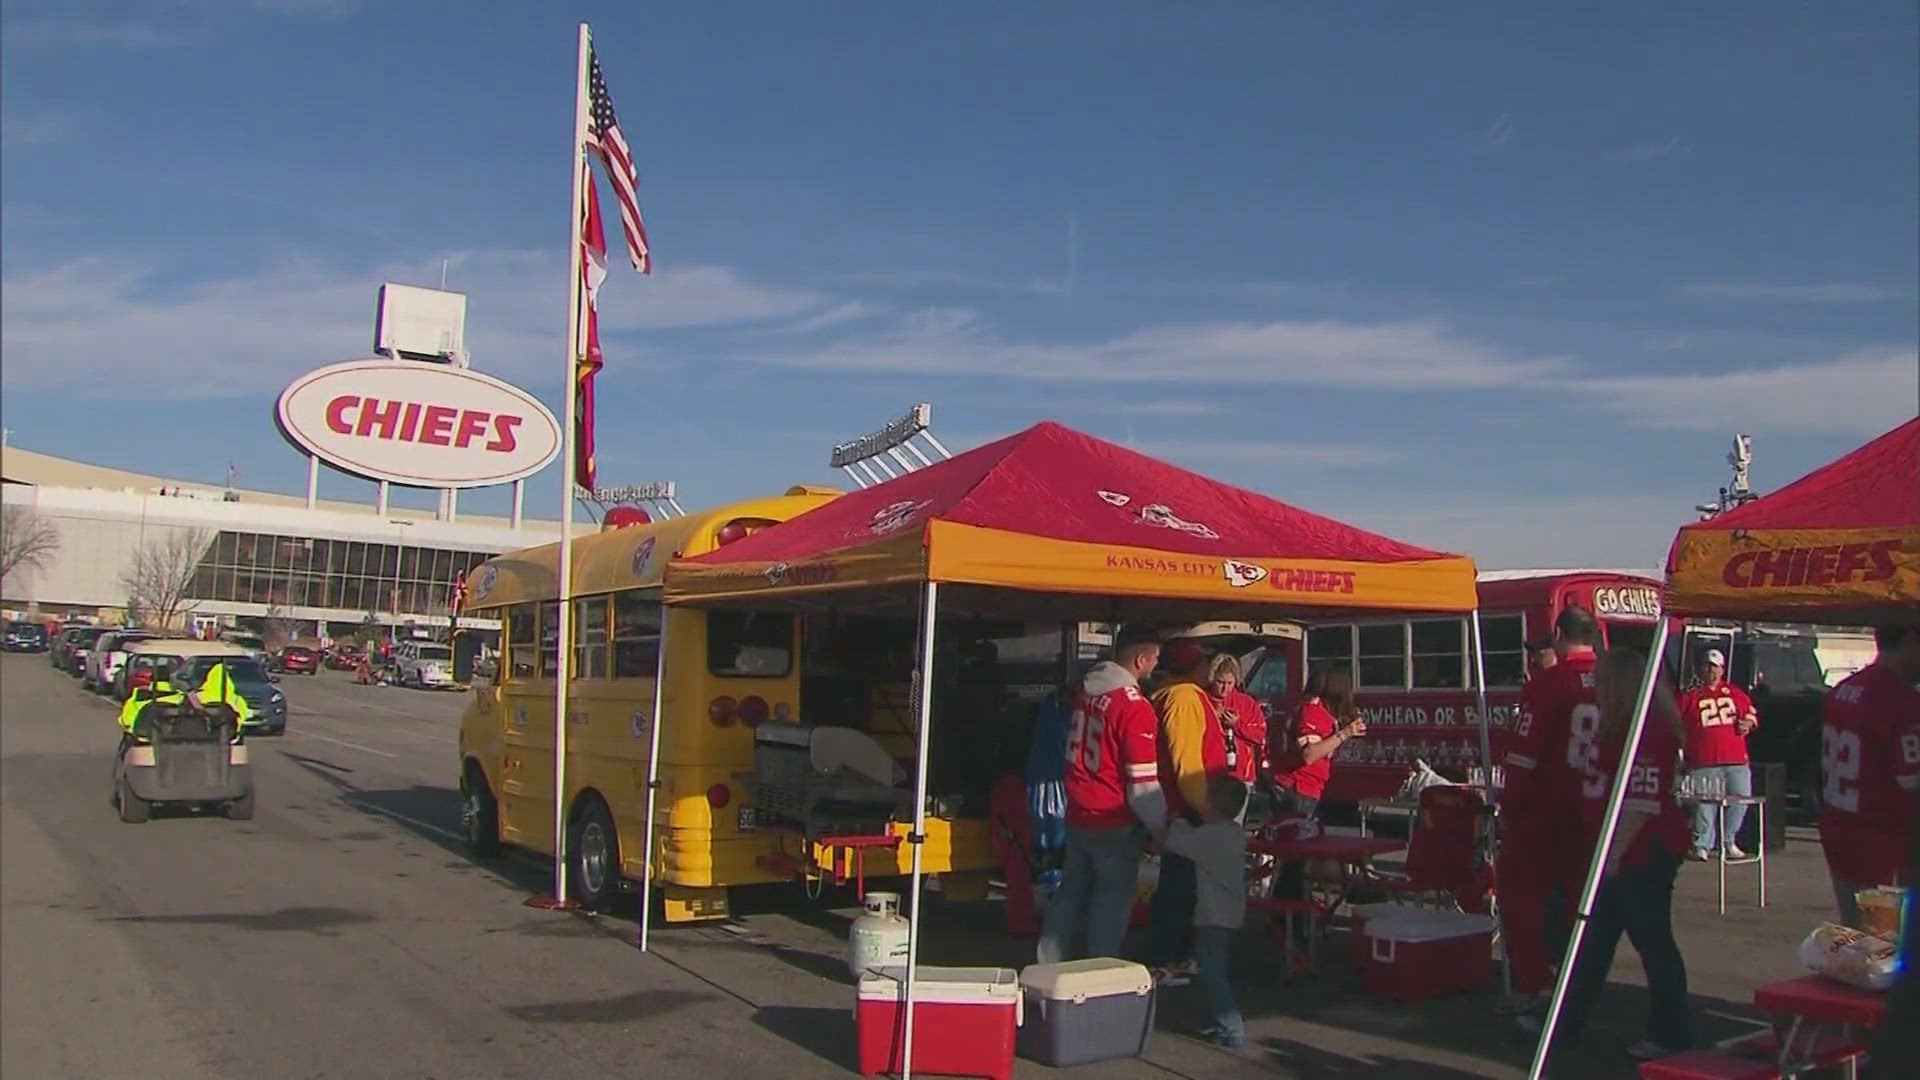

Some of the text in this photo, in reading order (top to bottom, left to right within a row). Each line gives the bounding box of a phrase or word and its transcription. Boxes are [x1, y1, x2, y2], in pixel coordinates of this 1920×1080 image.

[324, 395, 523, 453] CHIEFS
[1106, 555, 1217, 575] KANSAS CITY
[1723, 539, 1903, 588] CHIEFS
[1269, 567, 1356, 594] CHIEFS
[1595, 587, 1618, 612] GO
[1361, 705, 1427, 726] OWHEAD
[1434, 707, 1456, 726] OR
[1698, 696, 1737, 728] 22
[1630, 765, 1660, 795] 25
